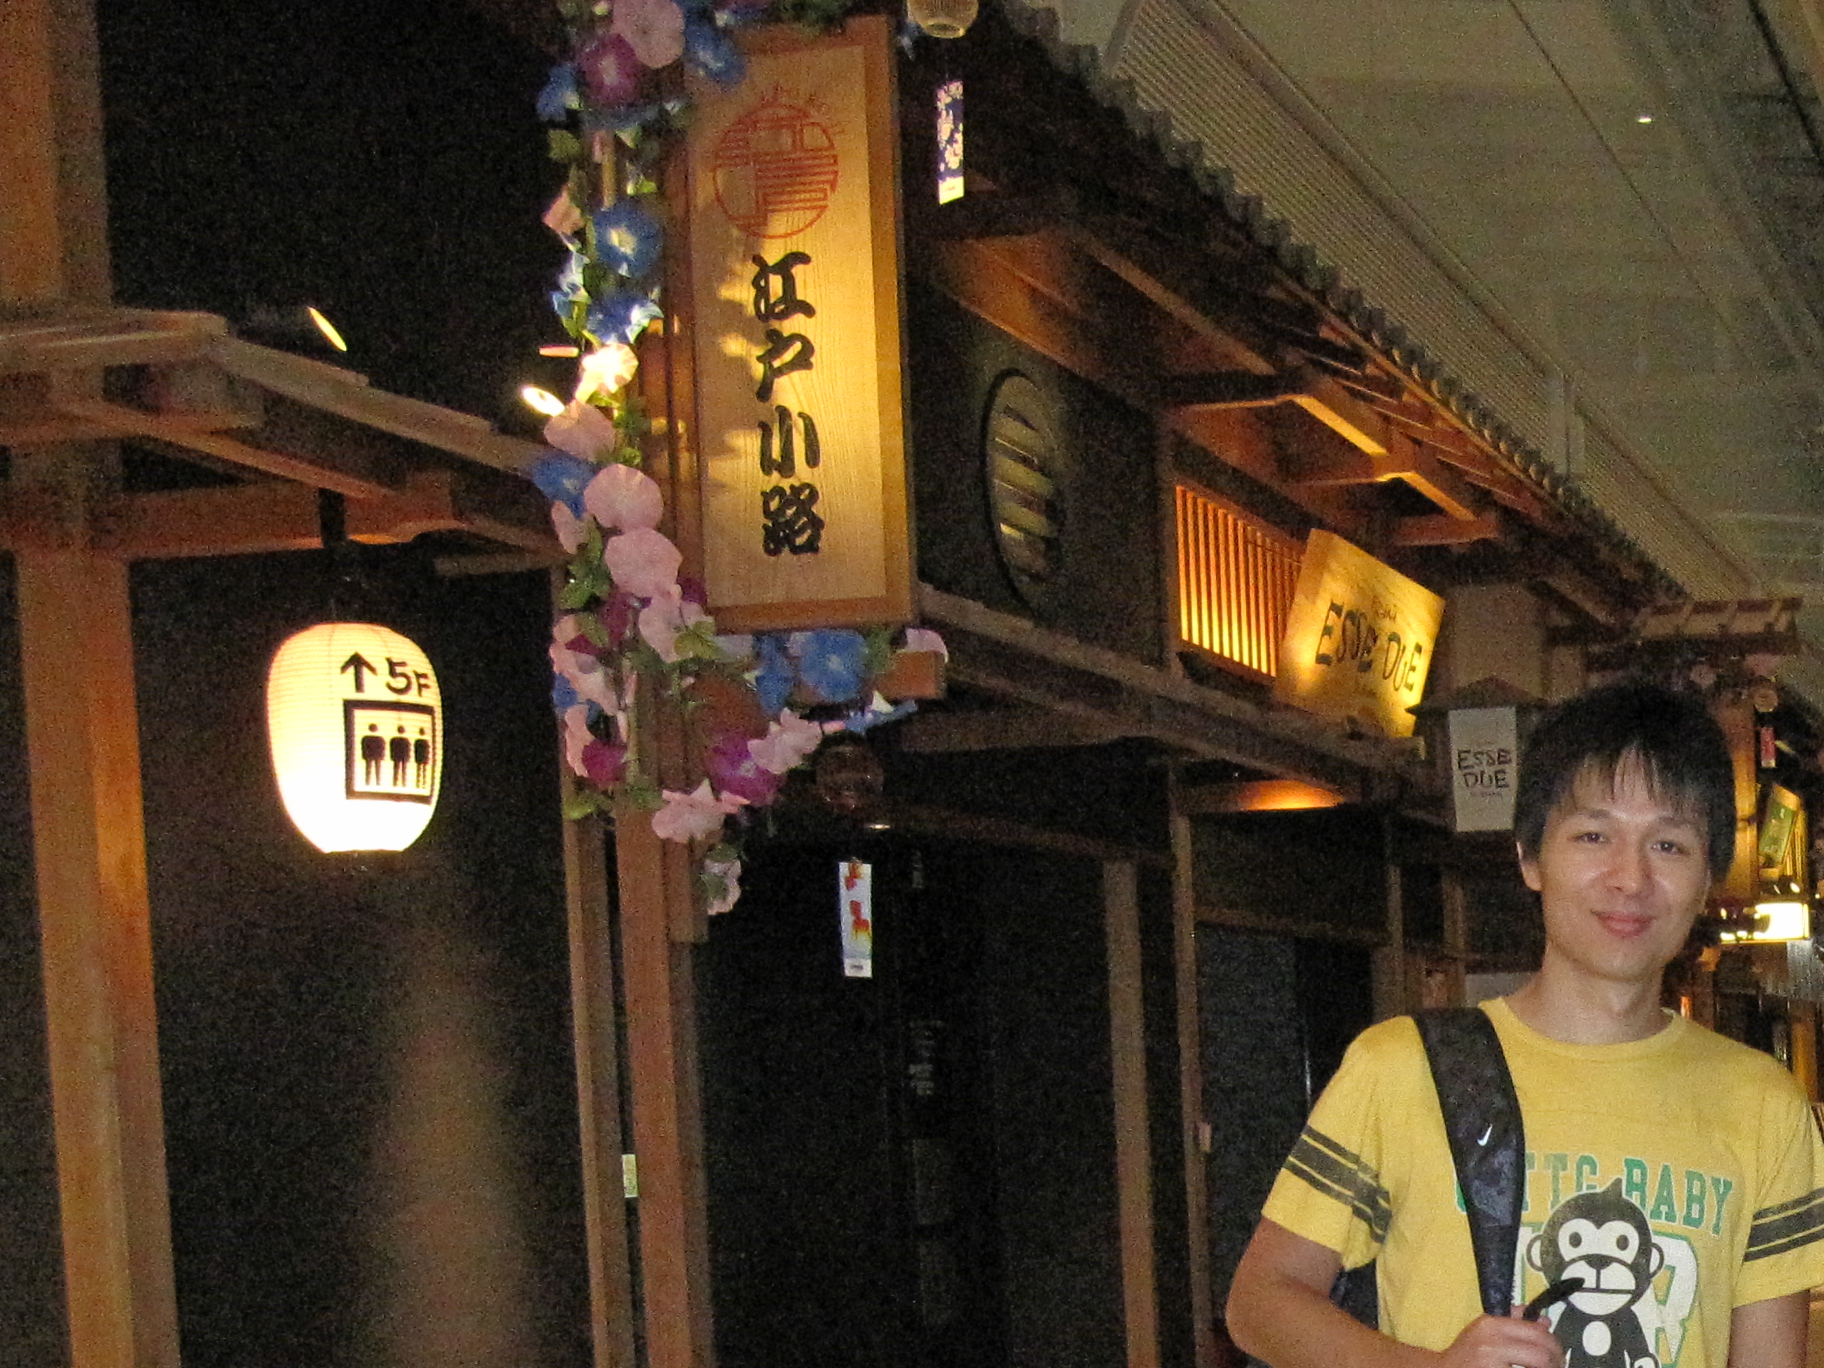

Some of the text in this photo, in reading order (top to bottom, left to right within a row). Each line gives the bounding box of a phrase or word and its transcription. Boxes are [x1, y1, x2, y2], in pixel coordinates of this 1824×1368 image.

[752, 250, 825, 557] 江戸小路
[1315, 601, 1423, 692] ESSE DUE
[385, 656, 431, 698] 5F
[1457, 748, 1512, 770] ESSE
[1463, 769, 1510, 789] DUE
[1624, 1157, 1733, 1236] BABY
